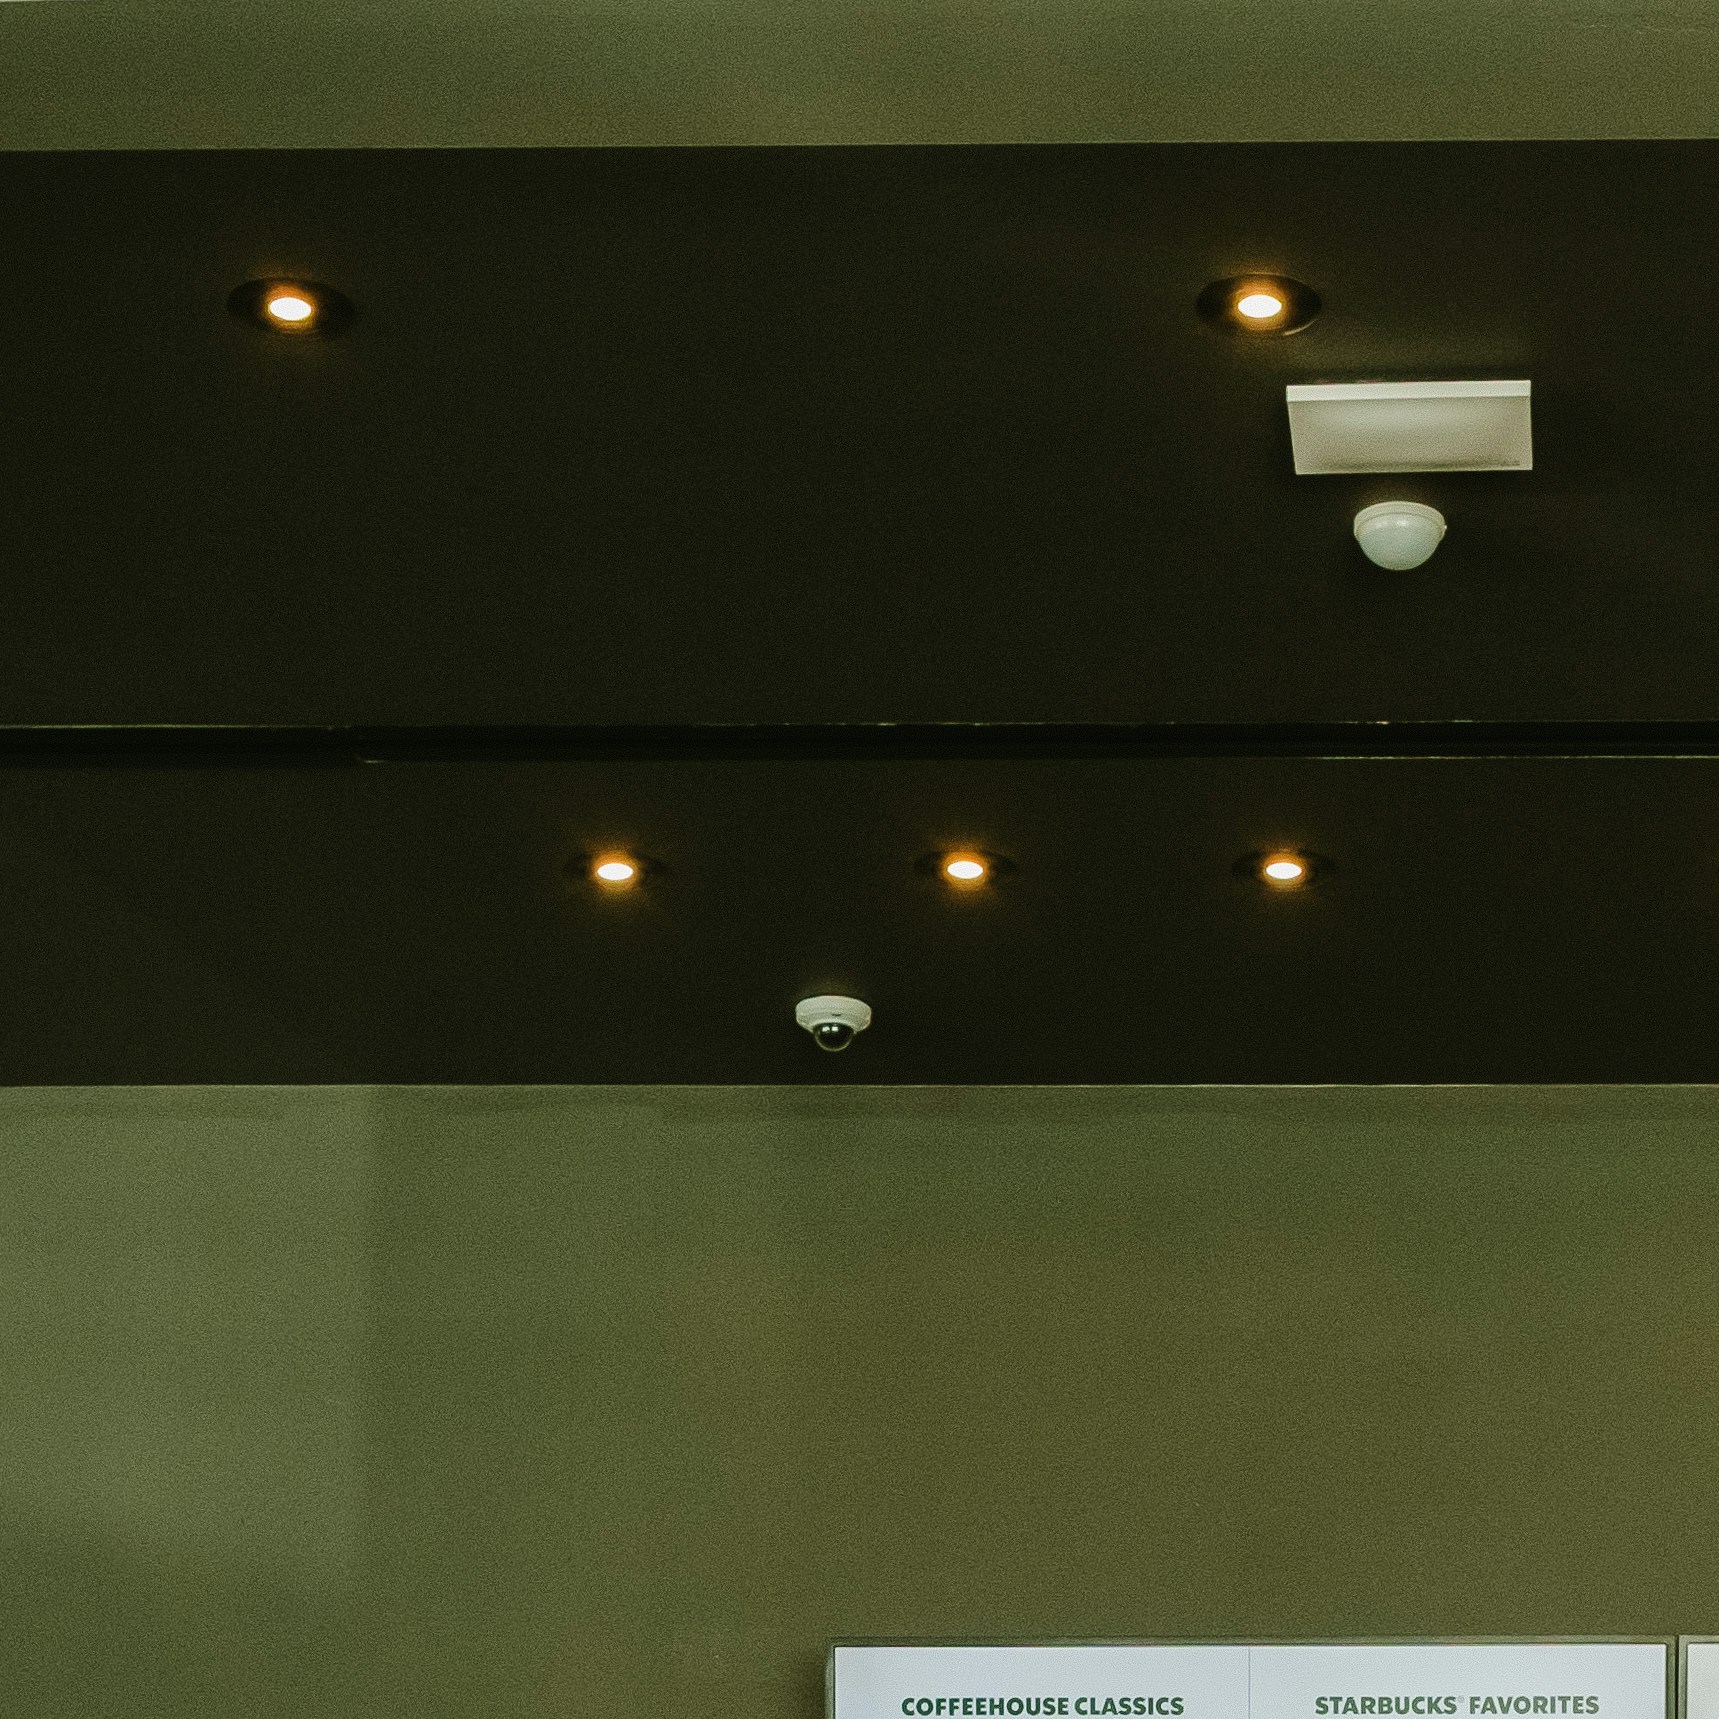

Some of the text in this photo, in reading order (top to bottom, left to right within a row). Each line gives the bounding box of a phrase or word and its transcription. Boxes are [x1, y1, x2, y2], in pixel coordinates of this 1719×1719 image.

[902, 1697, 1184, 1716] COFFEEHOUSE CLASSICS
[1470, 1696, 1599, 1714] FAVORITES
